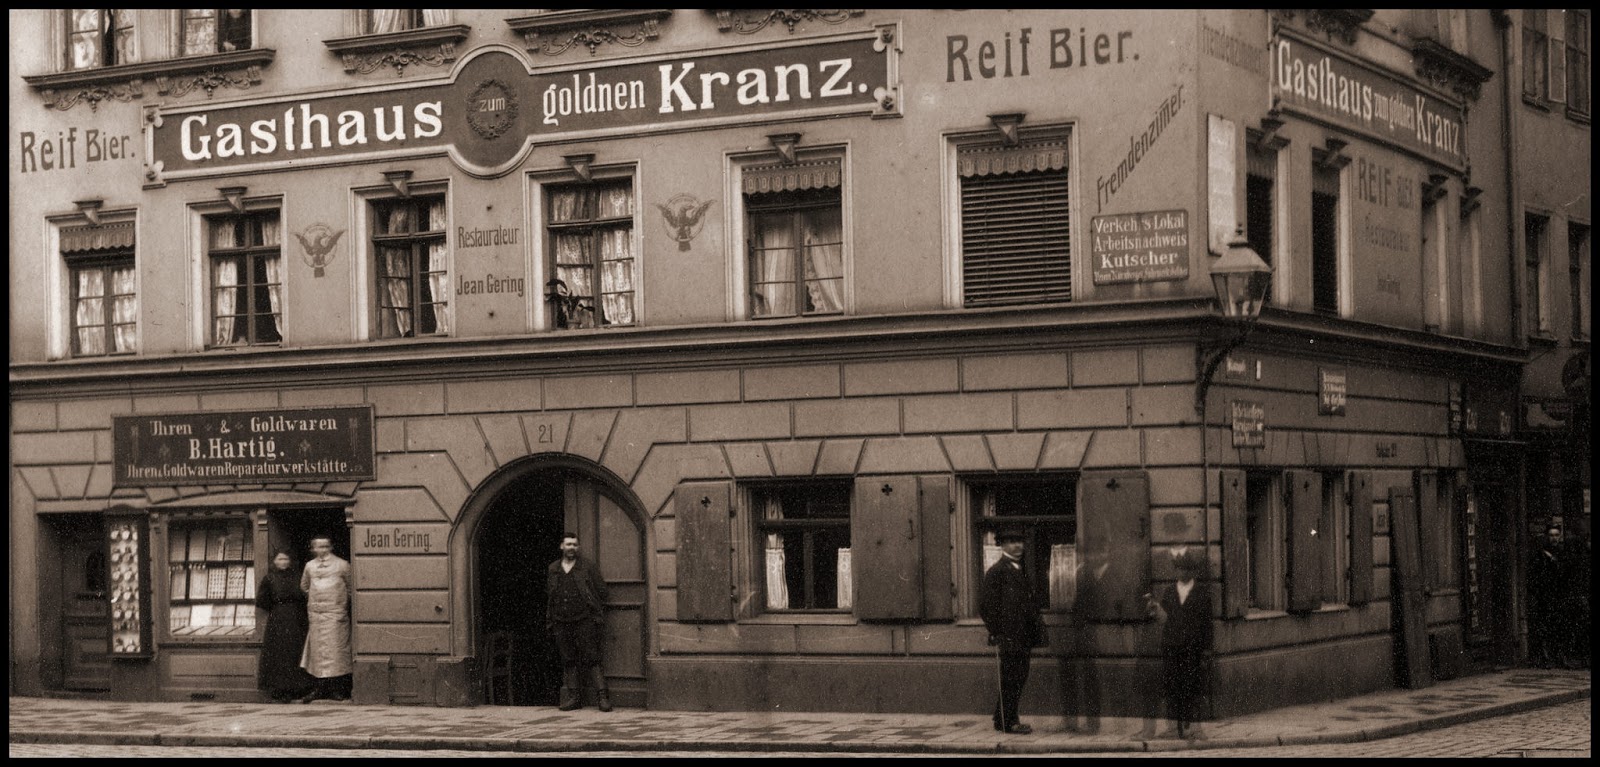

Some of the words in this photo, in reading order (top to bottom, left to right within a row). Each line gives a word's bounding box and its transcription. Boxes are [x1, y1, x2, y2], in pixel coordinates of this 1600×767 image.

[946, 28, 1032, 83] Reif
[1050, 27, 1140, 70] Bier.
[180, 100, 443, 162] Gasthaus
[479, 96, 506, 113] zum
[542, 74, 646, 126] goldnen
[658, 57, 868, 115] Kranz.
[1278, 40, 1373, 121] Gasthaus
[1374, 92, 1389, 121] zum
[1416, 94, 1460, 156] Kranz
[20, 127, 77, 174] Reif
[86, 129, 136, 163] Bier.
[1358, 157, 1392, 208] REIF
[1094, 217, 1151, 234] Verkehs
[1154, 212, 1185, 230] Lokal
[458, 225, 520, 248] Restaurateur
[1094, 232, 1187, 252] Arbeitsnachweis
[1101, 250, 1178, 269] Kutscher
[457, 275, 484, 296] Jean
[487, 273, 524, 297] Gering
[220, 419, 231, 434] &
[250, 416, 338, 433] Goldwaren
[538, 424, 553, 443] 21
[364, 528, 390, 548] Jean
[393, 527, 432, 552] Gering.
